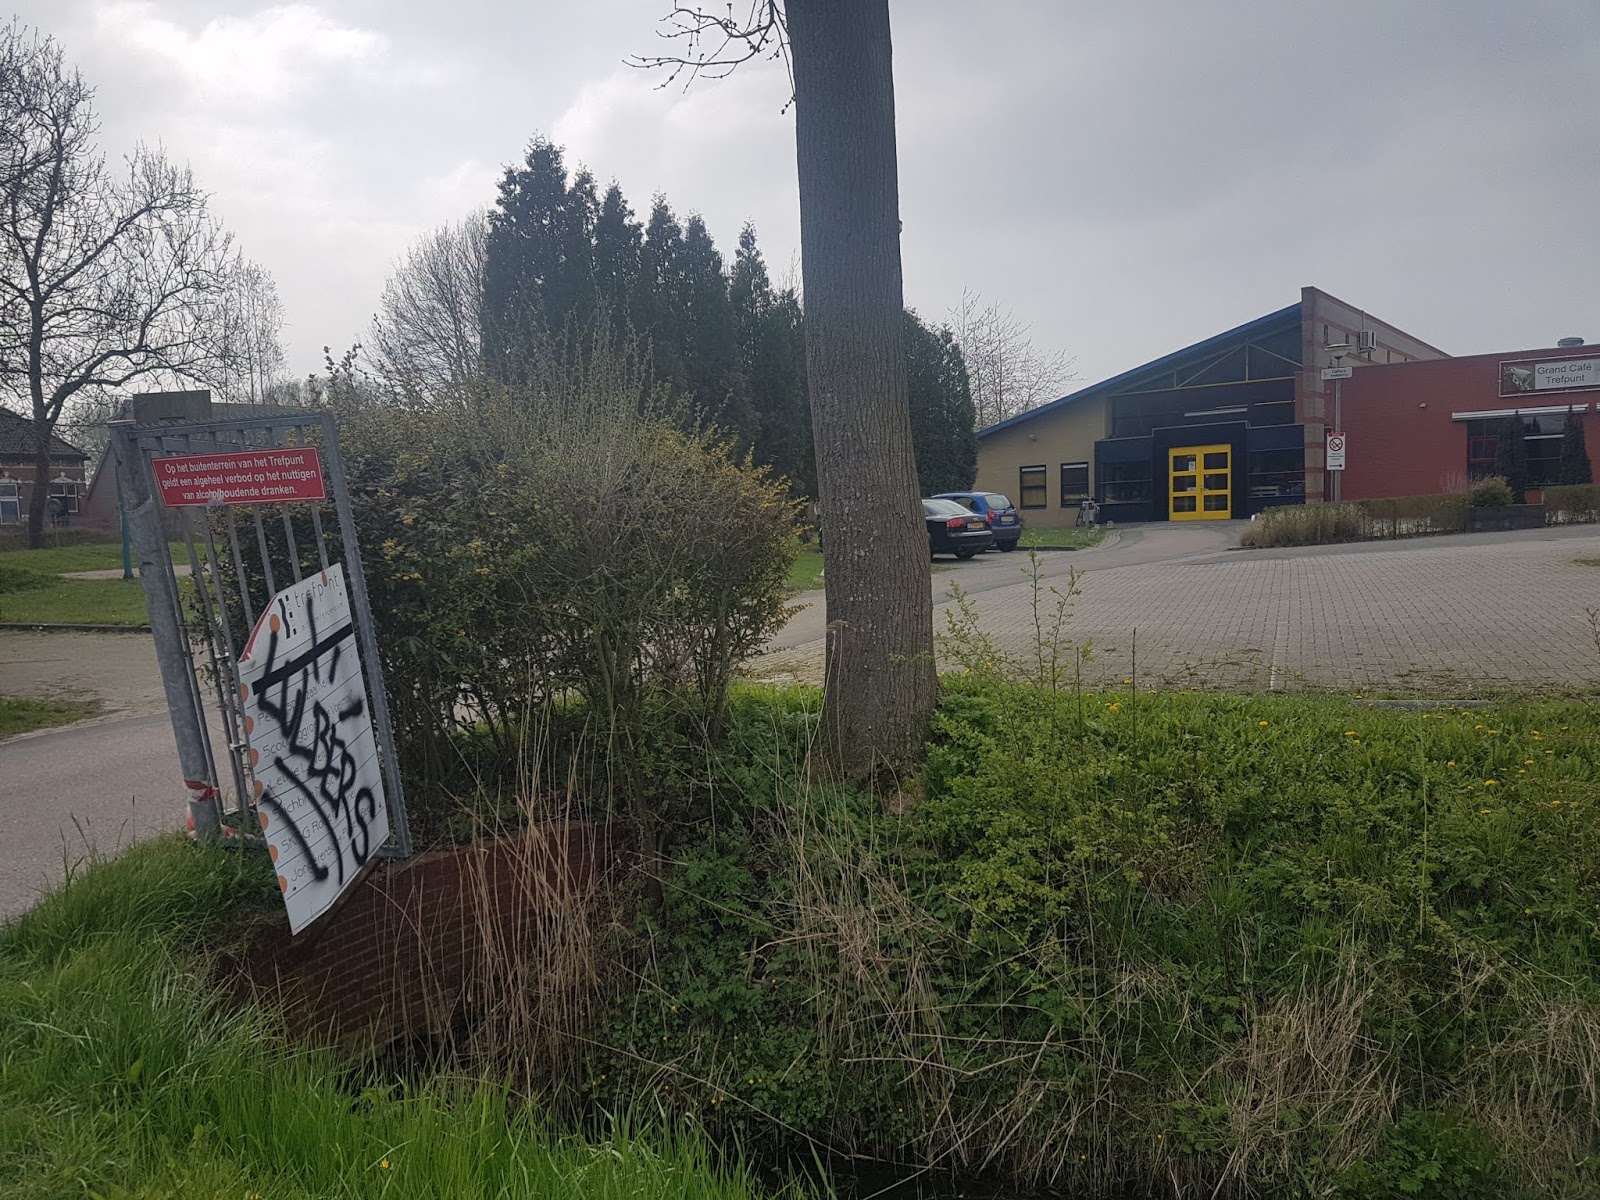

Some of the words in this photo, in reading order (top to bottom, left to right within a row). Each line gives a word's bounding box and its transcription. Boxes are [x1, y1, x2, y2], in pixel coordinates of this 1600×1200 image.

[1537, 365, 1567, 375] Grand
[1569, 362, 1592, 372] Café
[1546, 374, 1585, 385] Trefpunt
[165, 463, 177, 475] Op
[177, 463, 189, 473] het
[189, 460, 237, 472] buitenterrein
[237, 460, 252, 469] van
[253, 457, 267, 467] het
[268, 454, 304, 468] Trefpunt
[162, 477, 180, 490] geldt
[180, 478, 193, 487] een
[194, 474, 223, 488] algeheel
[225, 472, 252, 484] verbod
[254, 473, 265, 484] op
[266, 471, 280, 481] het
[281, 469, 317, 482] nuttigen
[182, 491, 195, 500] van
